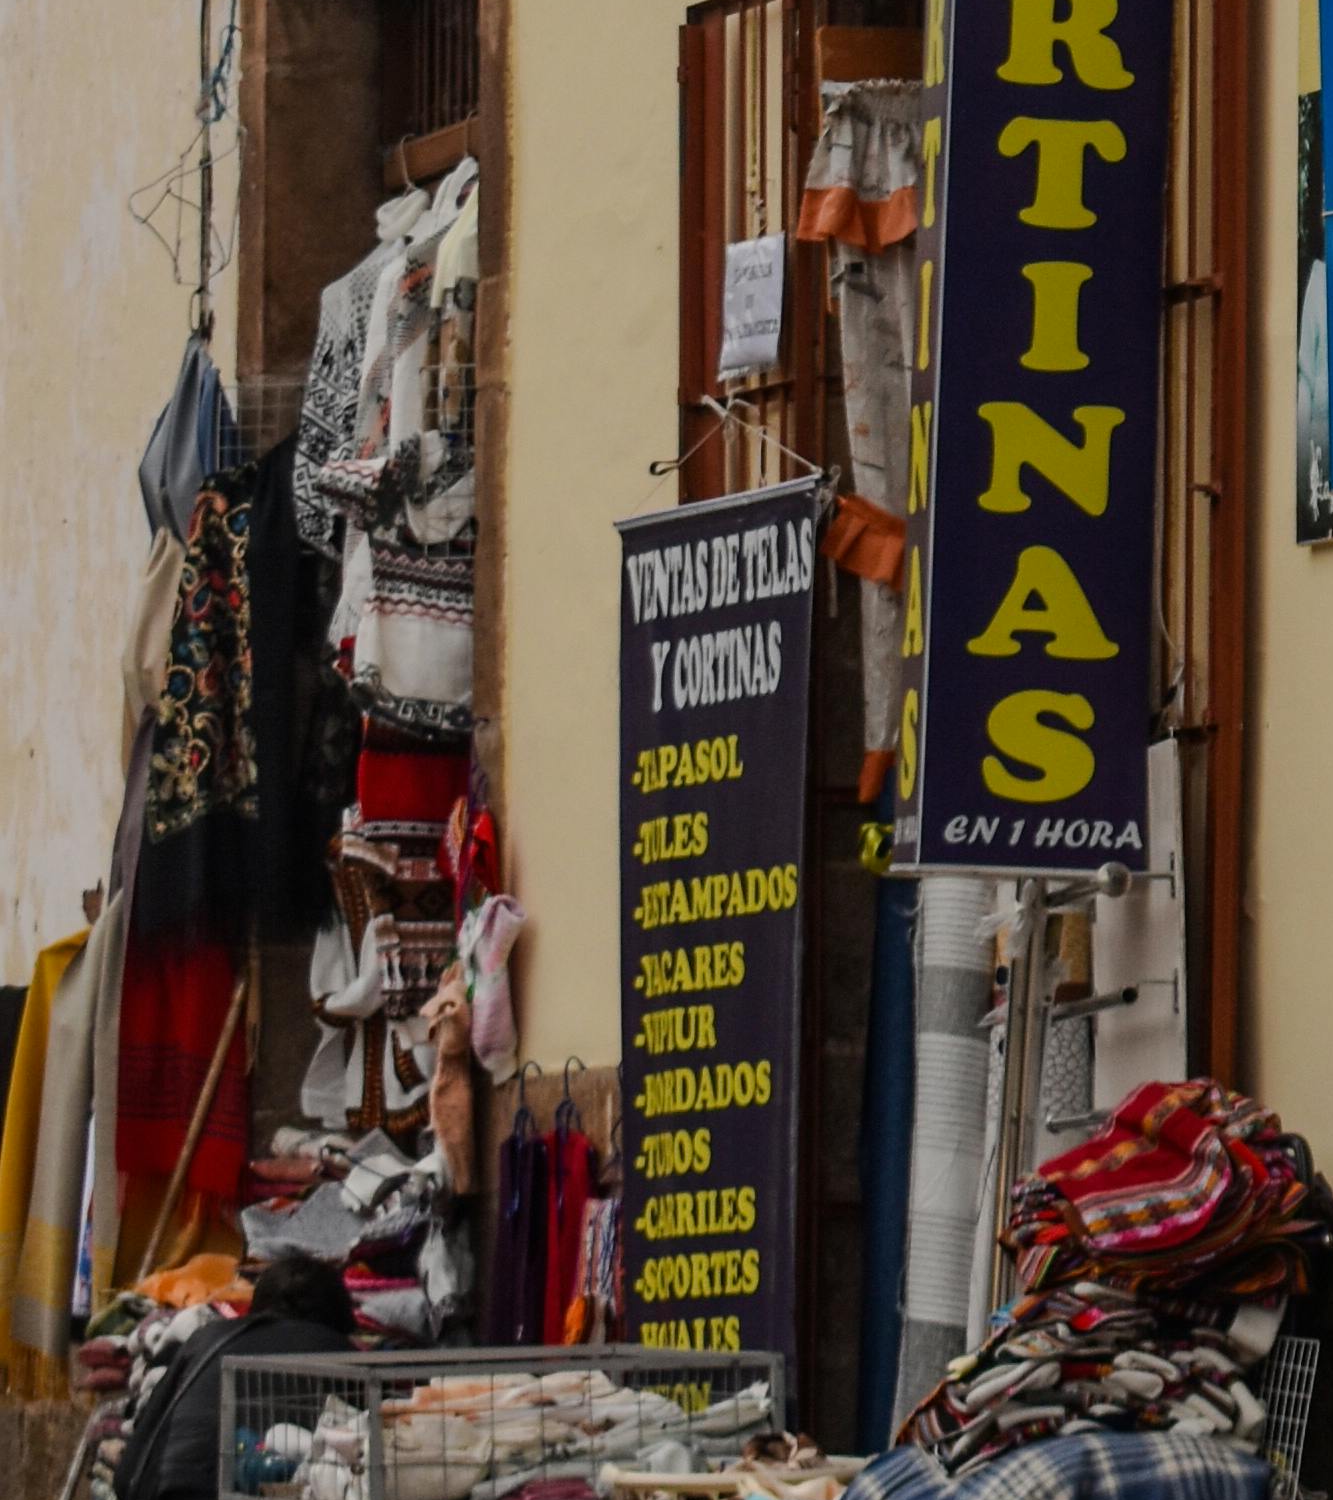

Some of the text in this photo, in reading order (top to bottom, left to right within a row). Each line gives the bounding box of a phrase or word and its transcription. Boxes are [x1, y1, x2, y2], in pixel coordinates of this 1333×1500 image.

[627, 517, 813, 625] VENTAS DE TELAS
[651, 620, 782, 714] Y CORTINAS
[944, 814, 1001, 845] EN
[1008, 819, 1026, 847] 1
[1033, 817, 1144, 850] HORA
